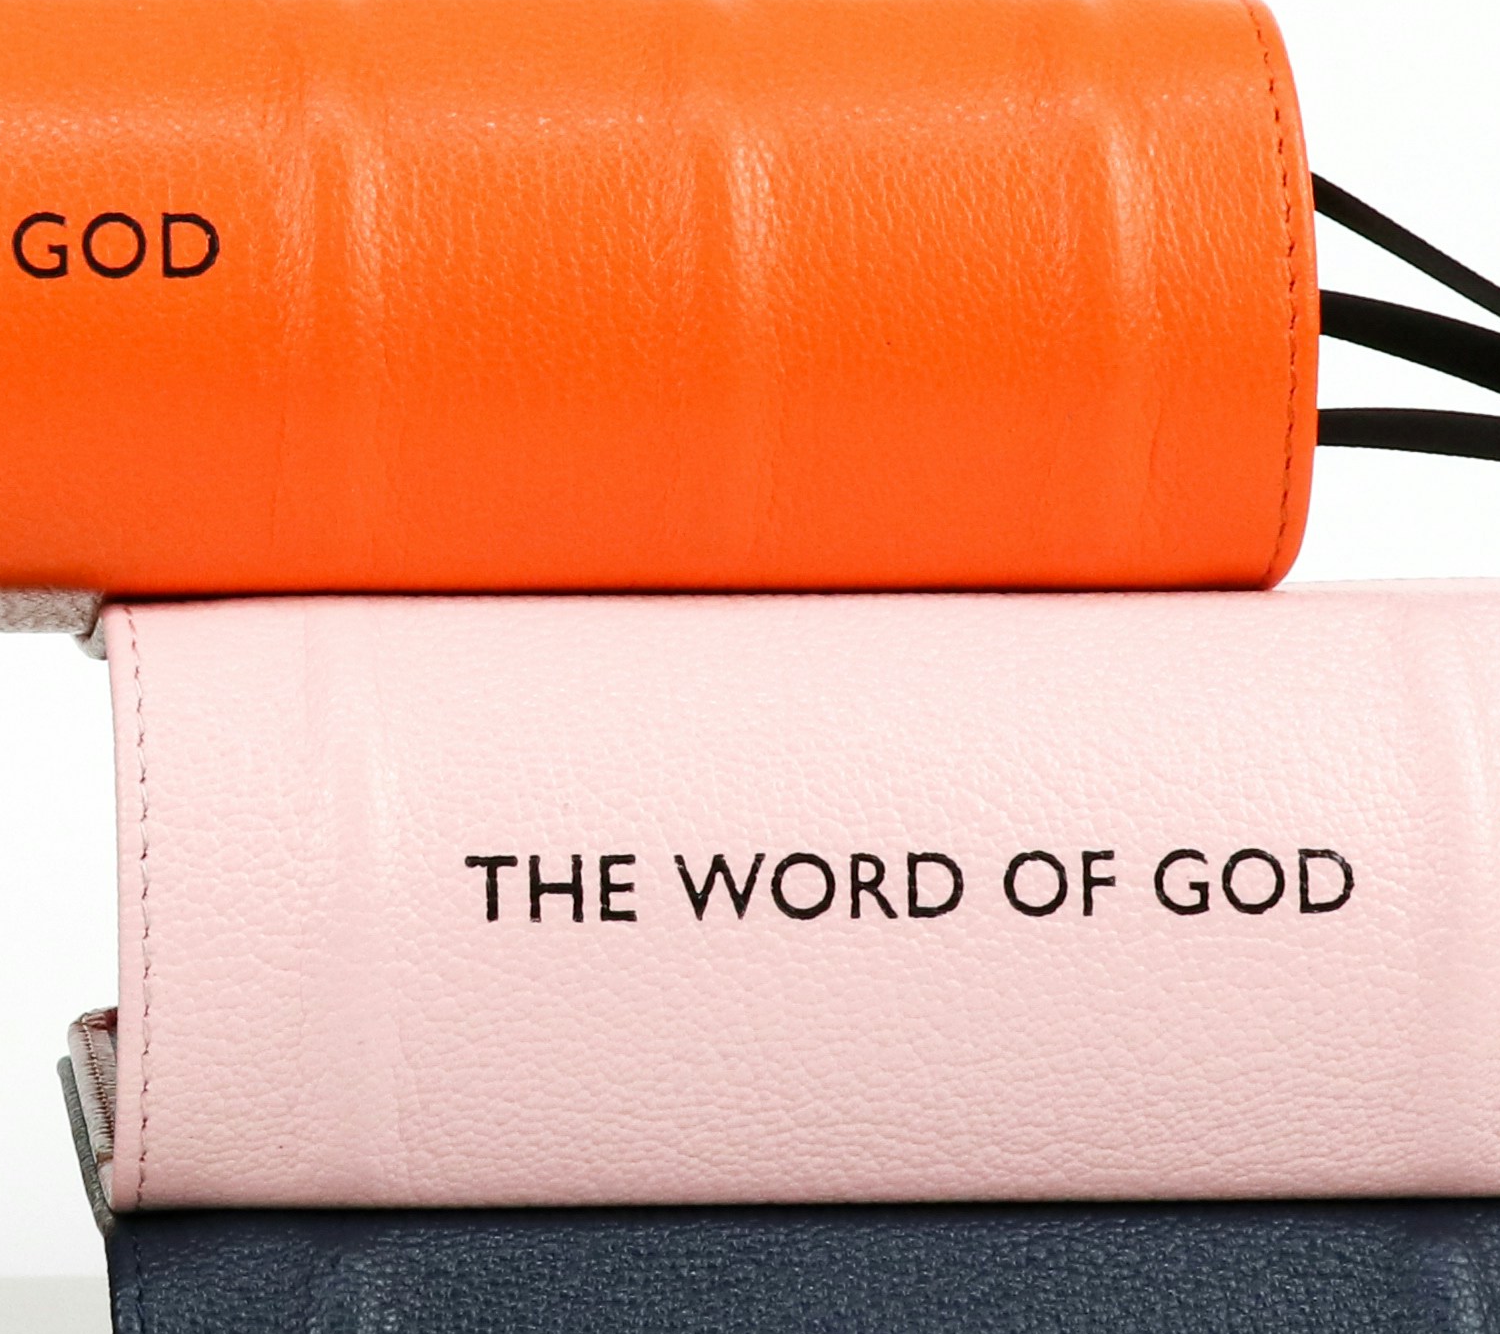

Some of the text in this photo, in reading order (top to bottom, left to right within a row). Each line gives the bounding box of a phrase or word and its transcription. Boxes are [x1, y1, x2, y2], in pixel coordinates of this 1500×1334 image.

[13, 212, 219, 279] GOD
[464, 848, 1355, 923] THE WORD OF GOD
